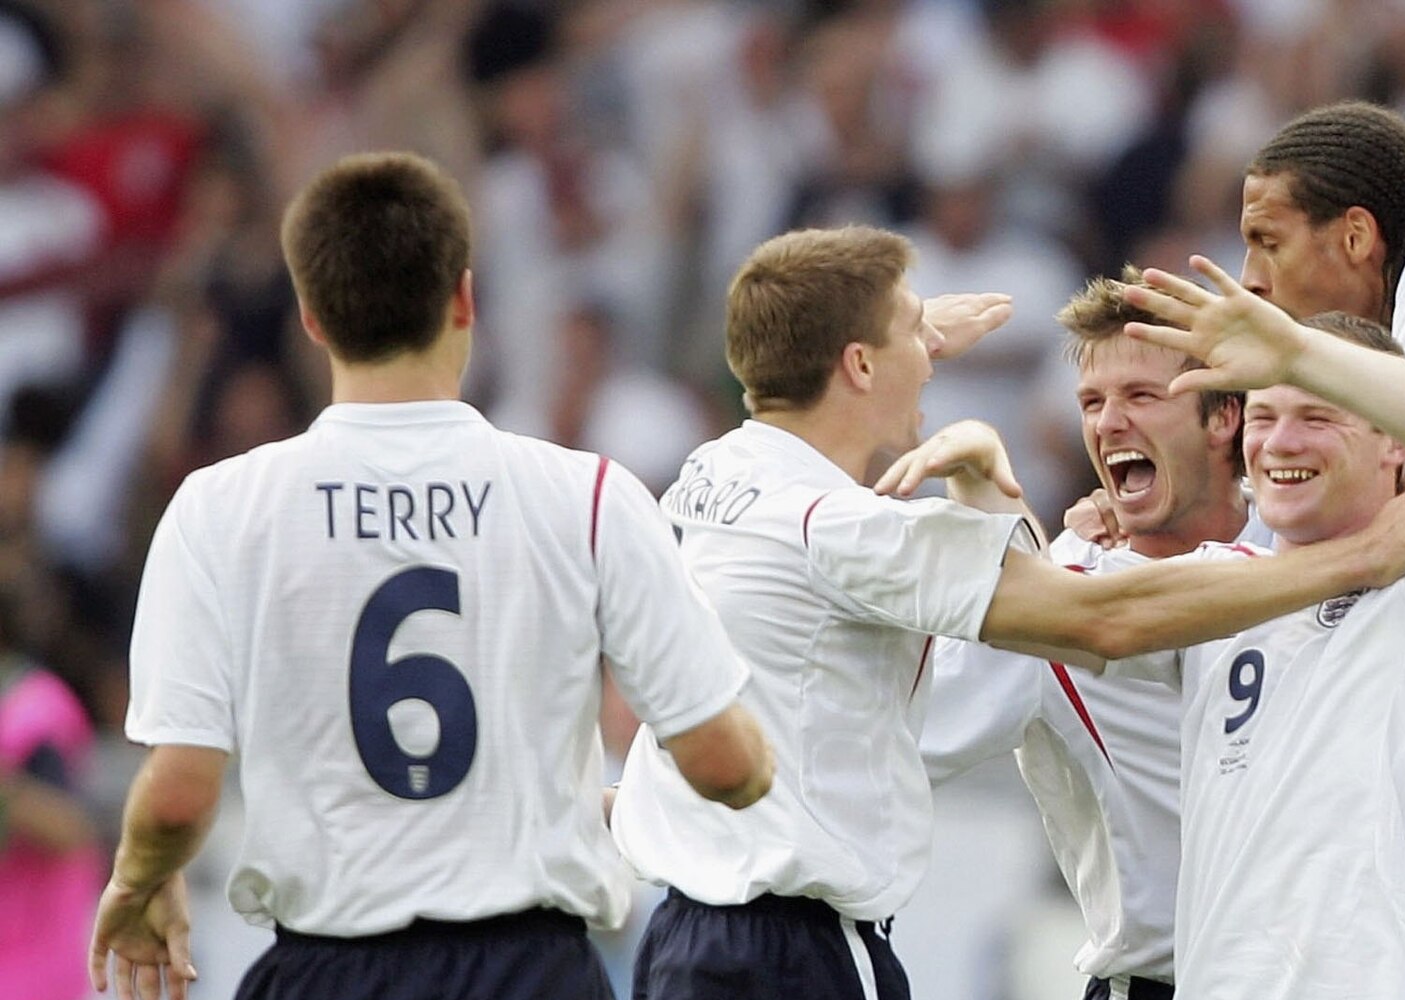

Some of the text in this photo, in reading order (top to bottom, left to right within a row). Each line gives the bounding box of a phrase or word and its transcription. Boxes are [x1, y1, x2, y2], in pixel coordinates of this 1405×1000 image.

[315, 480, 492, 541] TERRY
[350, 564, 478, 801] 6
[1224, 648, 1266, 735] 9
